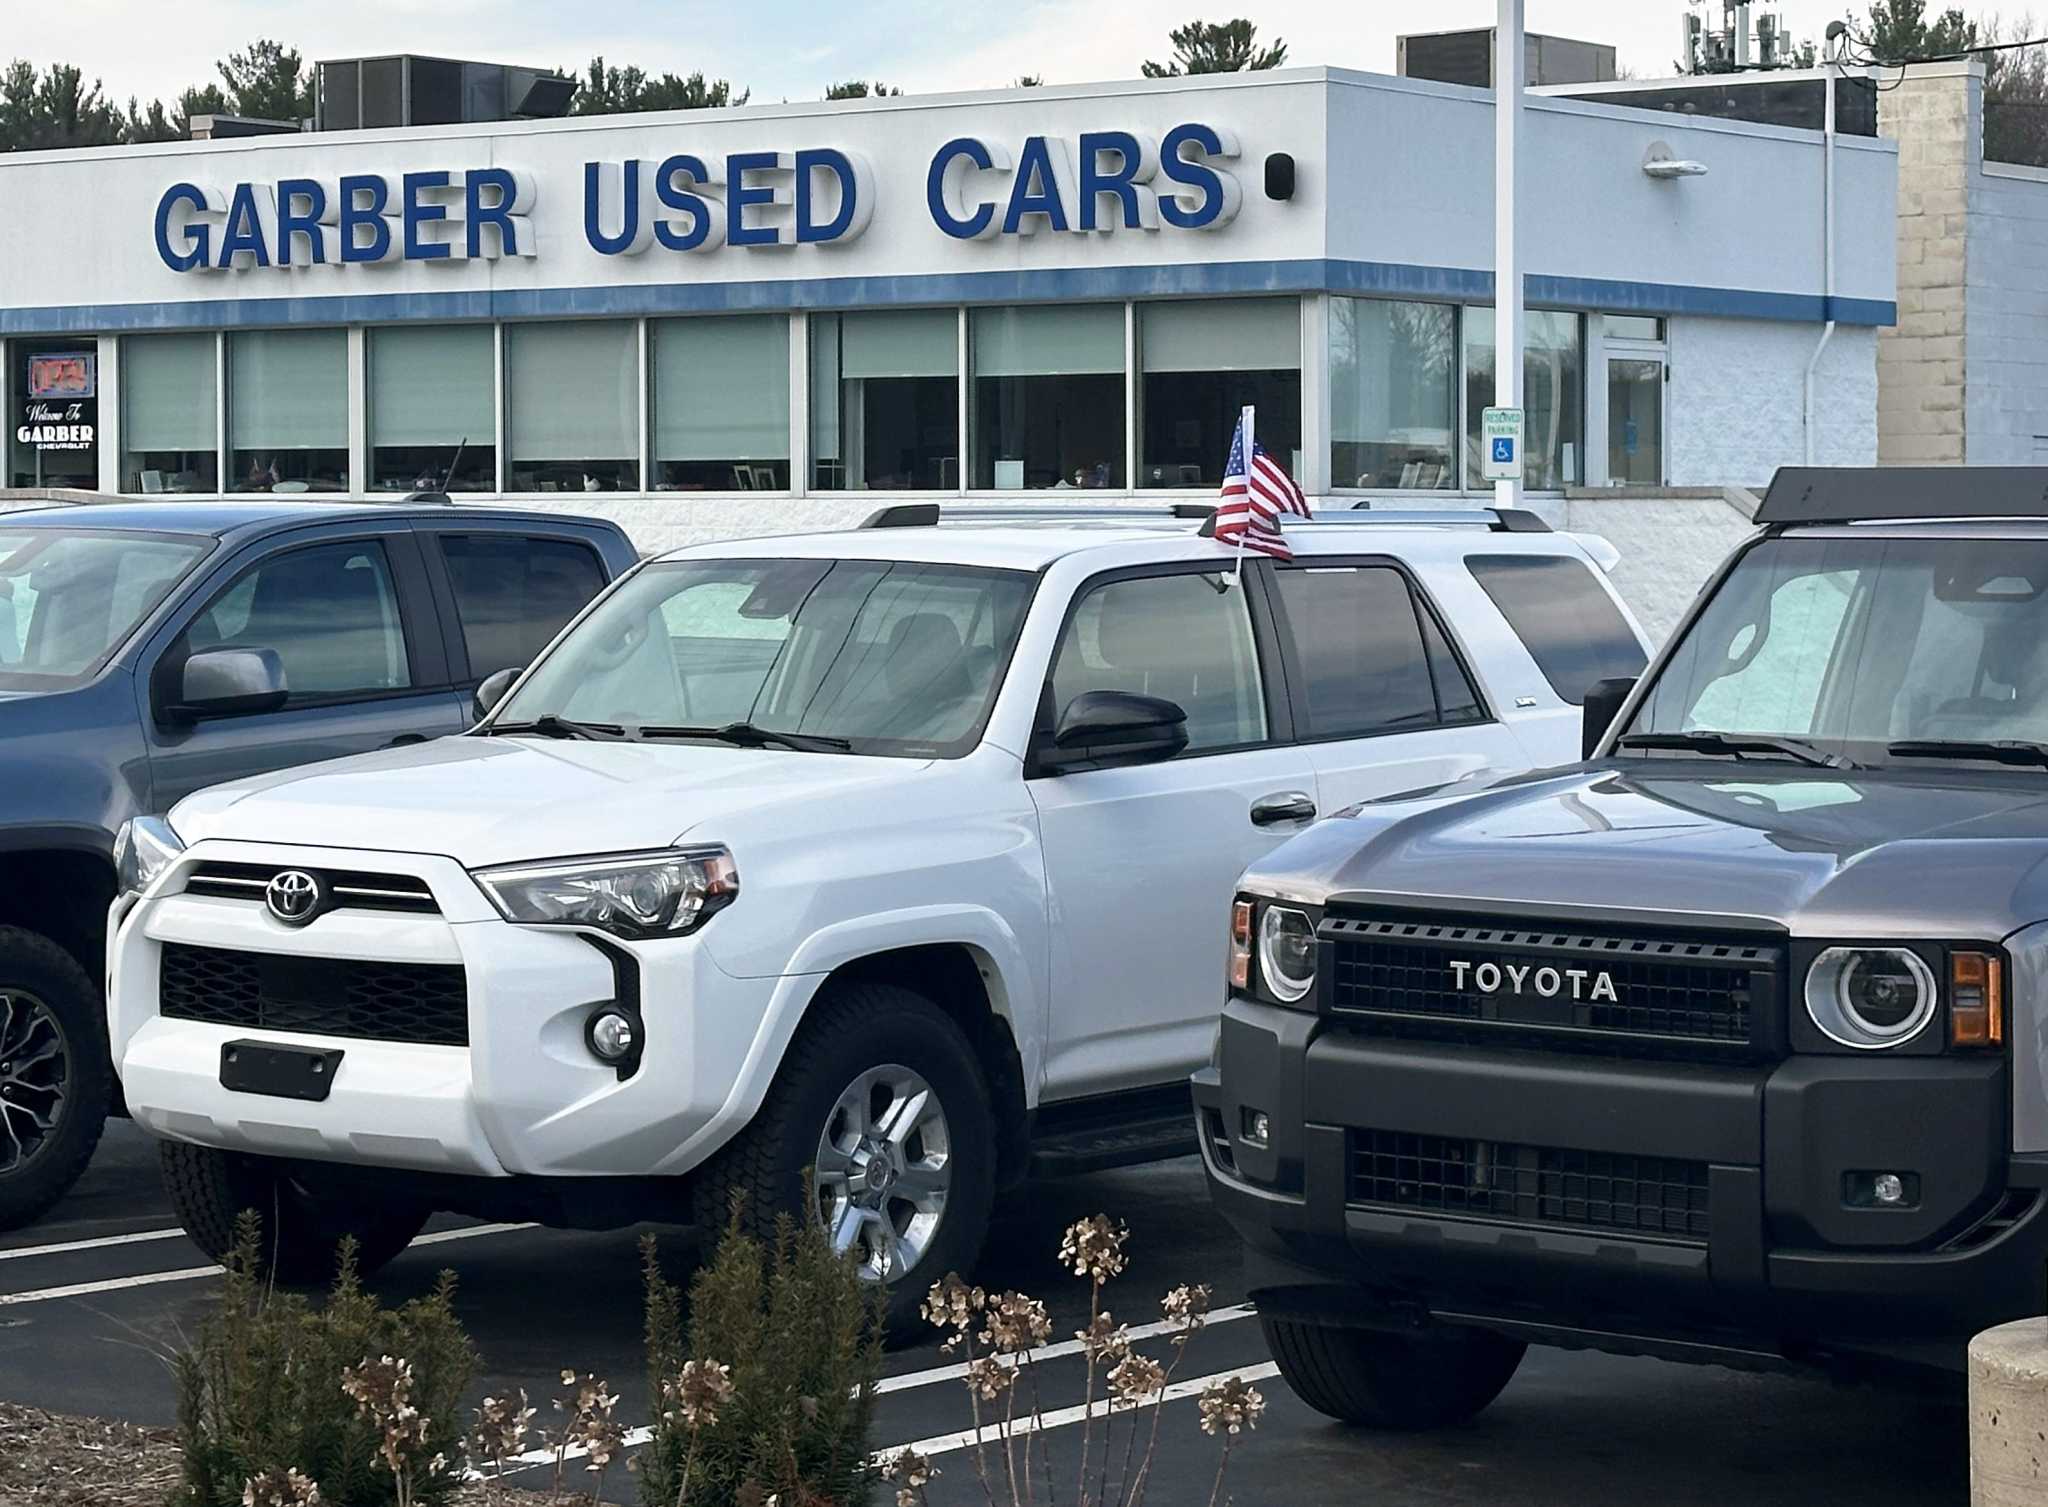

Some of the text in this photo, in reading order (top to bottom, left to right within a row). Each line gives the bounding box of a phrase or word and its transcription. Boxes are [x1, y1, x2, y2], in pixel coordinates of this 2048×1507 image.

[155, 123, 1226, 272] GARBER USED CARS
[17, 425, 94, 443] GARBER
[36, 442, 90, 450] CHEVROLET
[1450, 960, 1618, 1002] TOYOTA
